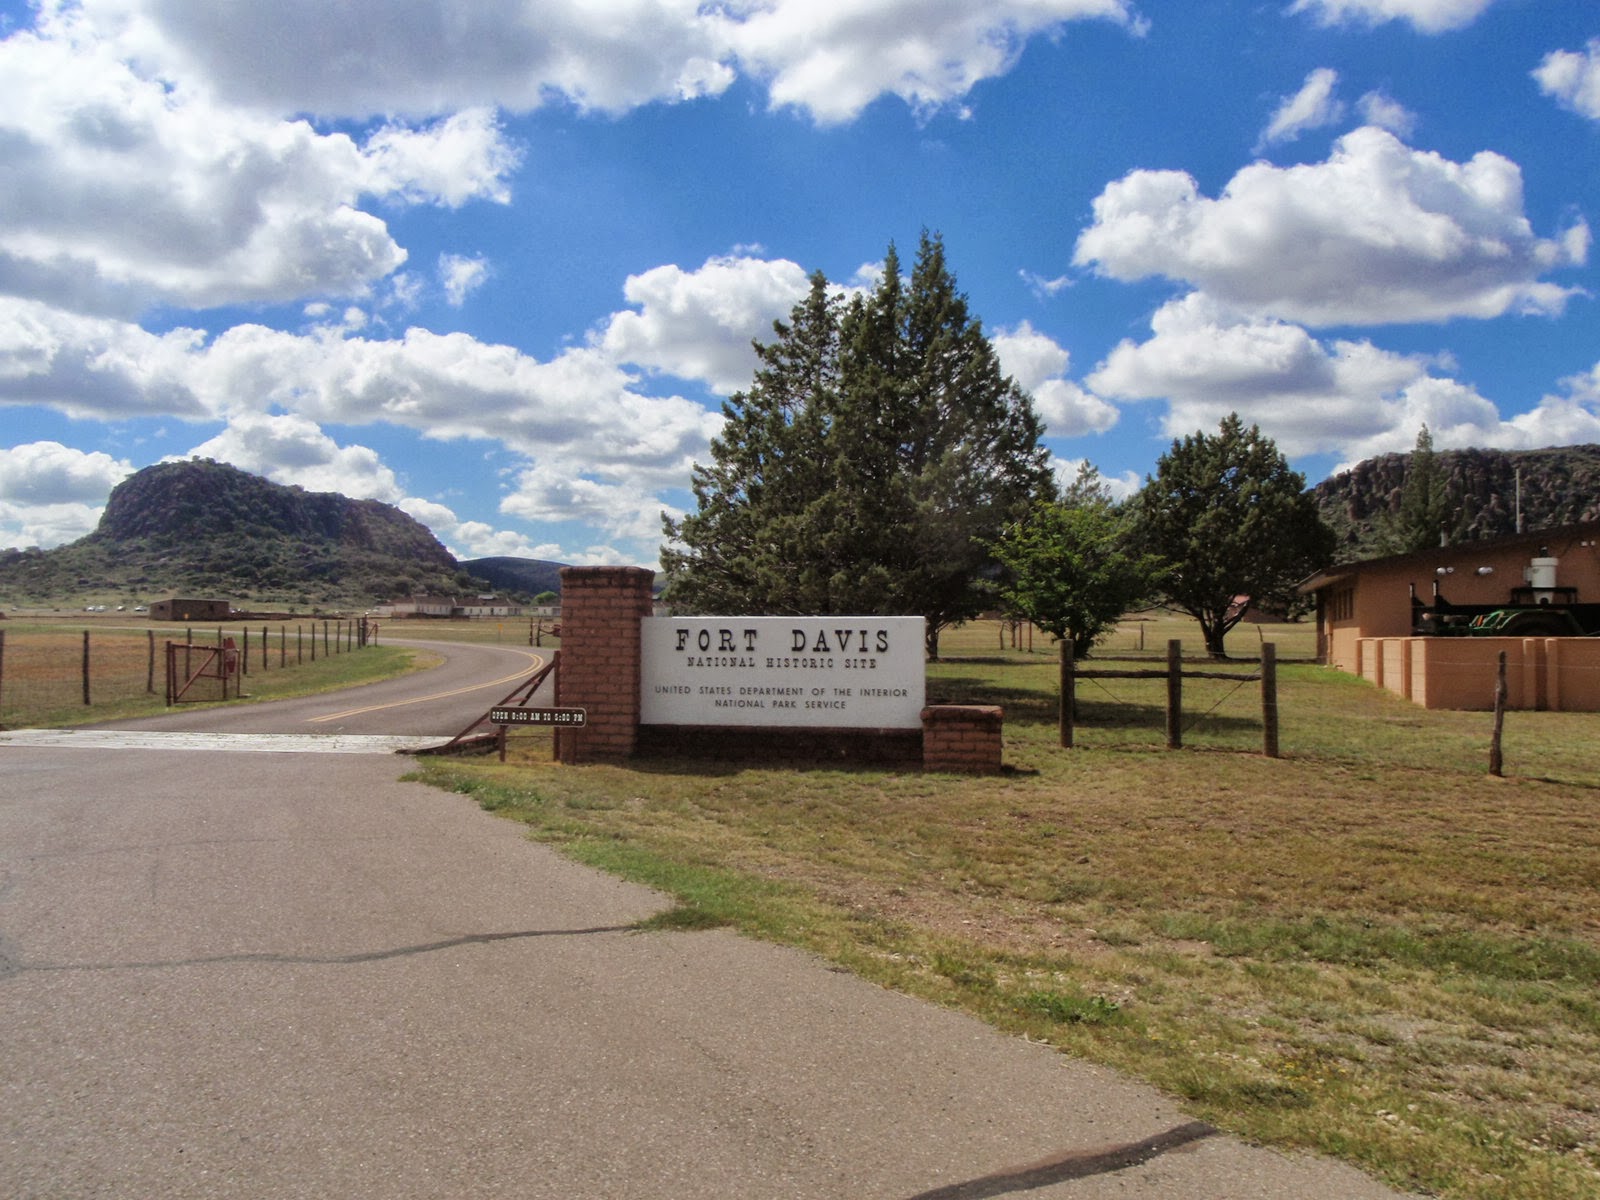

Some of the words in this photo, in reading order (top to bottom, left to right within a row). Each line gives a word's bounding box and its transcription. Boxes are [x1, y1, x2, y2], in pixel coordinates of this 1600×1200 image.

[676, 628, 758, 653] FORT
[790, 629, 889, 653] DAVIS
[687, 656, 756, 668] NATIONAL
[765, 658, 835, 669] HISTORIC
[844, 658, 877, 669] SITE
[655, 685, 692, 695] UNITED
[698, 686, 732, 696] STATES
[739, 686, 804, 696] DEPARTMENT
[811, 687, 825, 697] OF
[833, 687, 853, 697] THE
[860, 687, 908, 698] INTERIOR
[714, 699, 765, 709] NATIONAL
[772, 700, 797, 709] PARK
[804, 700, 846, 710] SERVICE
[492, 711, 509, 720] OPEN
[530, 712, 540, 721] AM
[573, 713, 583, 722] PM
